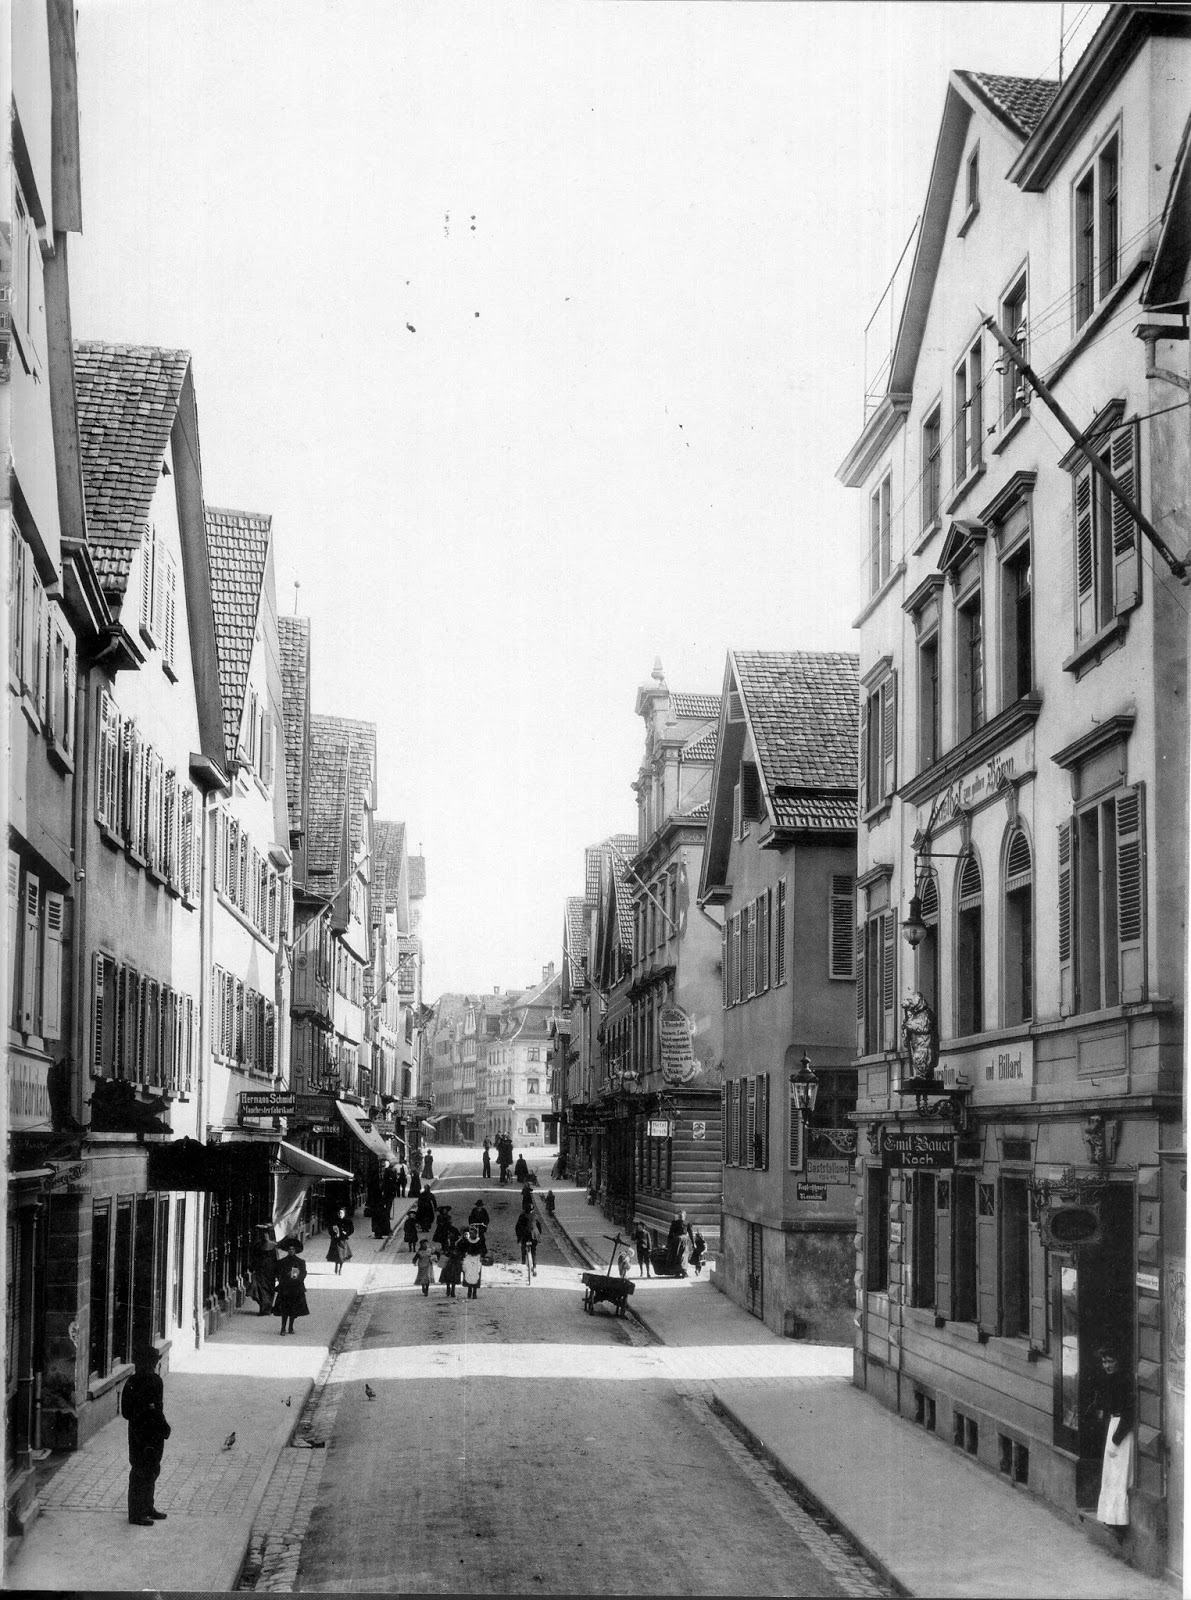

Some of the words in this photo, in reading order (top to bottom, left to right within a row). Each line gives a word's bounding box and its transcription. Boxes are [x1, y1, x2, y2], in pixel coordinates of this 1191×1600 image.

[241, 1092, 269, 1104] Hermann
[269, 1093, 296, 1105] Schmidt
[883, 1134, 912, 1151] Emil
[914, 1134, 951, 1152] Bauer
